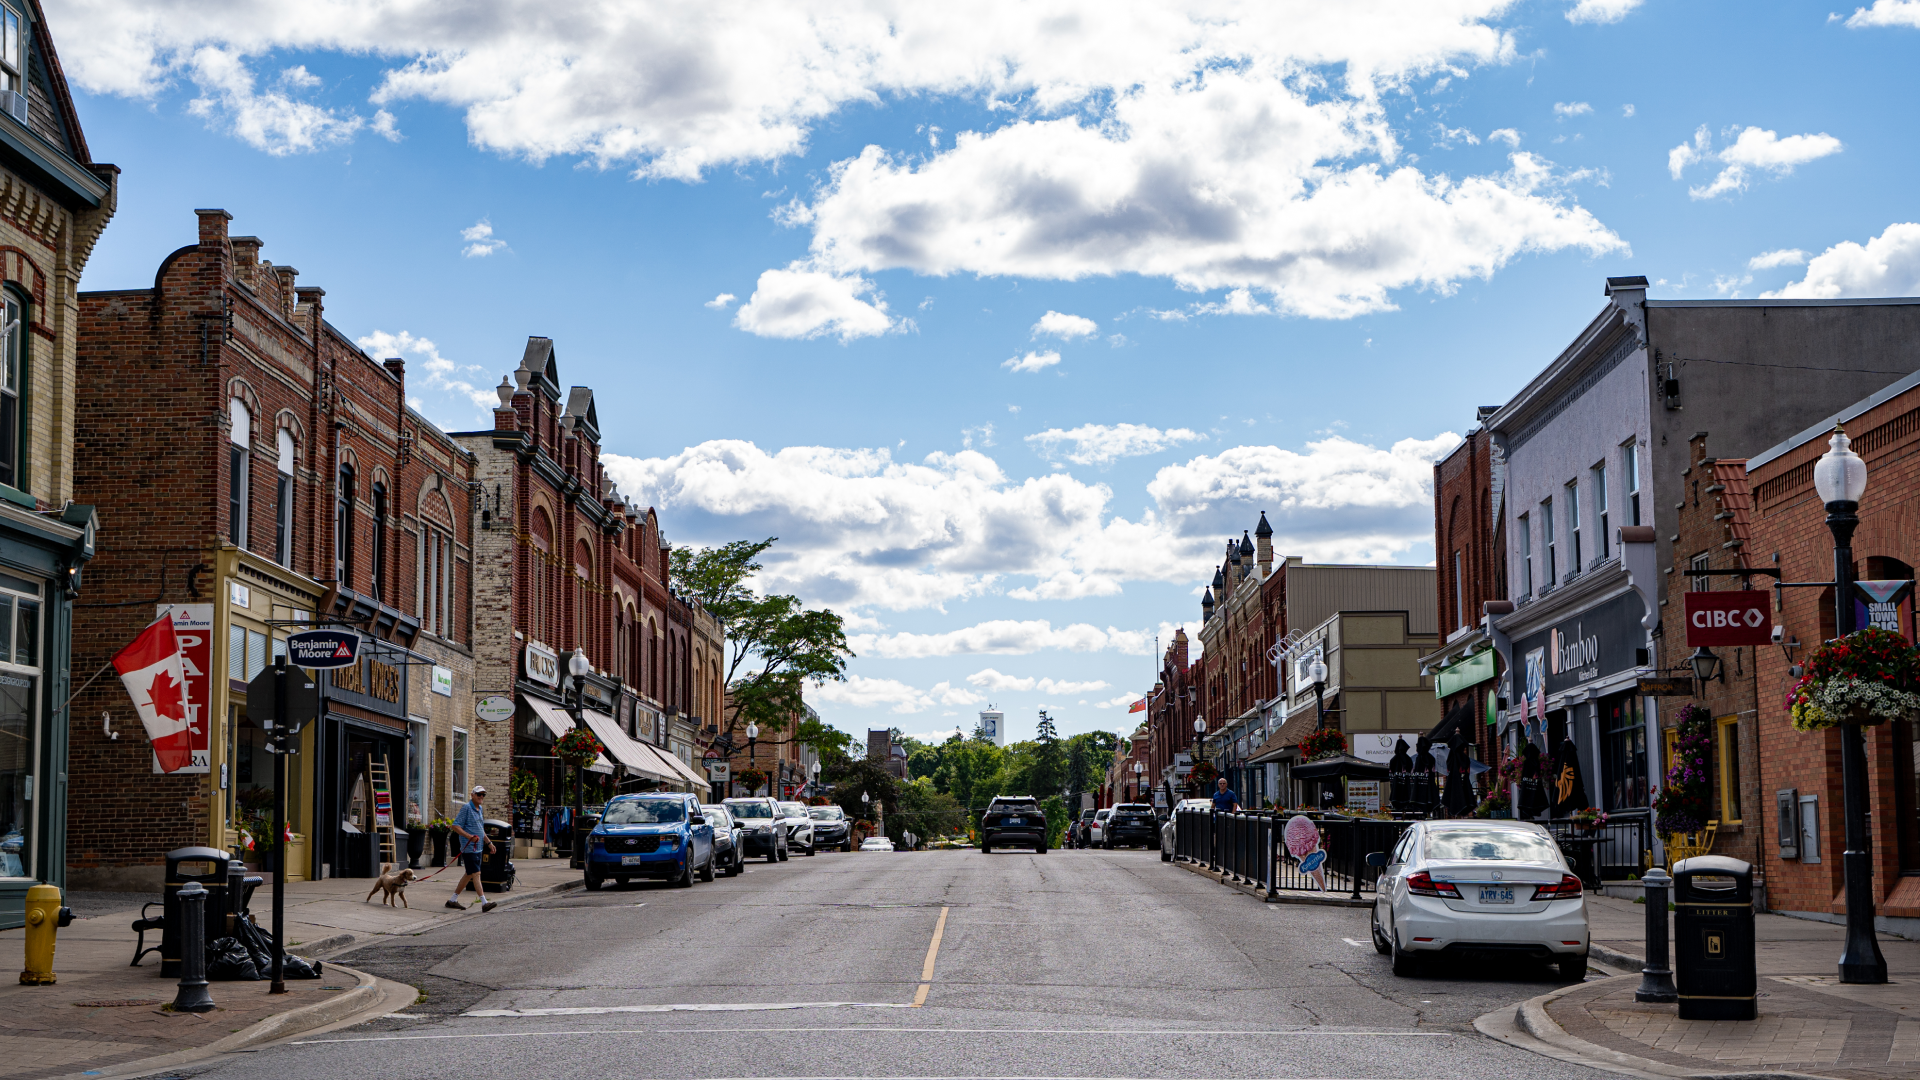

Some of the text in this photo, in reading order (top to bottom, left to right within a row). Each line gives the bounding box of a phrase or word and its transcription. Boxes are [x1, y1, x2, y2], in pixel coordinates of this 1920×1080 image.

[1868, 602, 1897, 612] SMALL
[1692, 609, 1742, 628] CIBC
[1869, 611, 1898, 622] TOWN
[291, 639, 339, 652] Benjamin
[1558, 621, 1598, 674] Bamboo
[298, 650, 331, 658] Moore
[370, 658, 400, 704] VOICES
[1640, 682, 1673, 692] SAFFRON
[1301, 852, 1324, 872] Kawartha
[1480, 890, 1513, 900] AYRV 645
